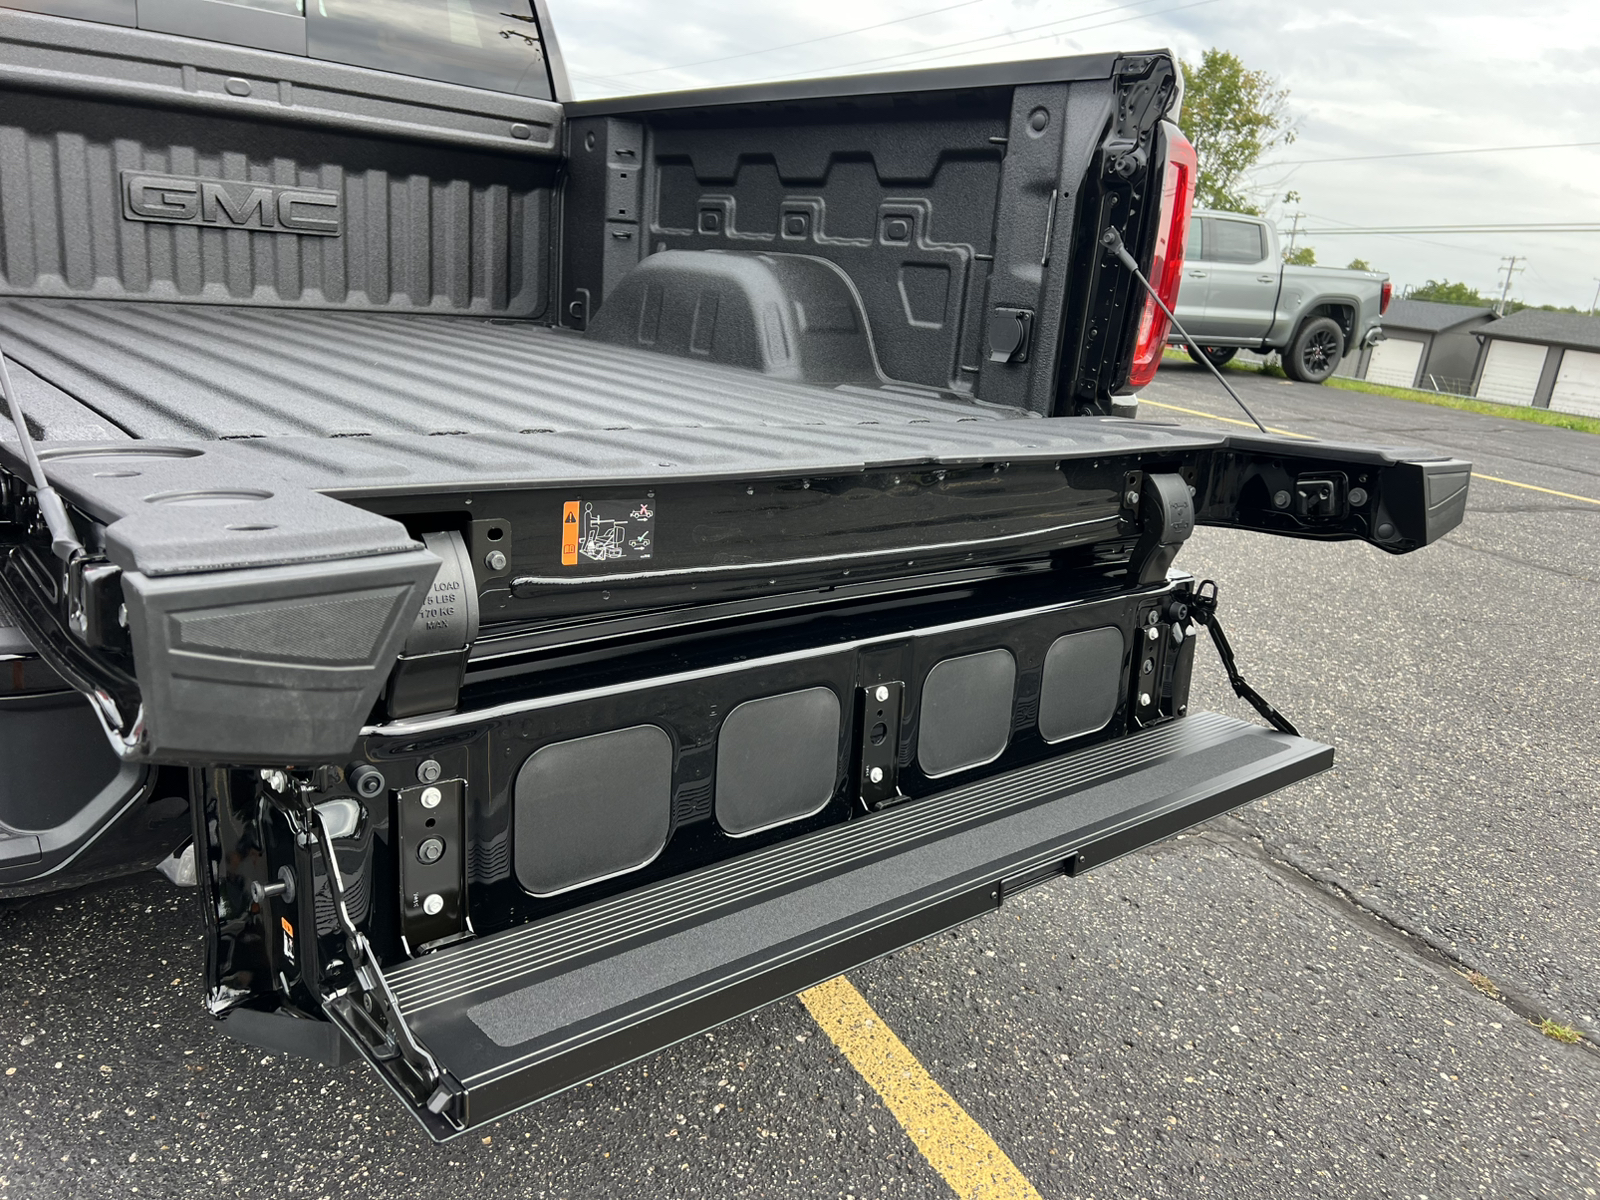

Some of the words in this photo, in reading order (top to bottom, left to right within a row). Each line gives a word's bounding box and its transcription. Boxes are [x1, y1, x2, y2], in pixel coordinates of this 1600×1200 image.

[127, 176, 339, 233] GMC
[434, 581, 460, 592] LOAD
[436, 594, 455, 604] LBS
[419, 609, 437, 619] 170
[440, 607, 454, 617] KG
[426, 620, 448, 630] MAX
